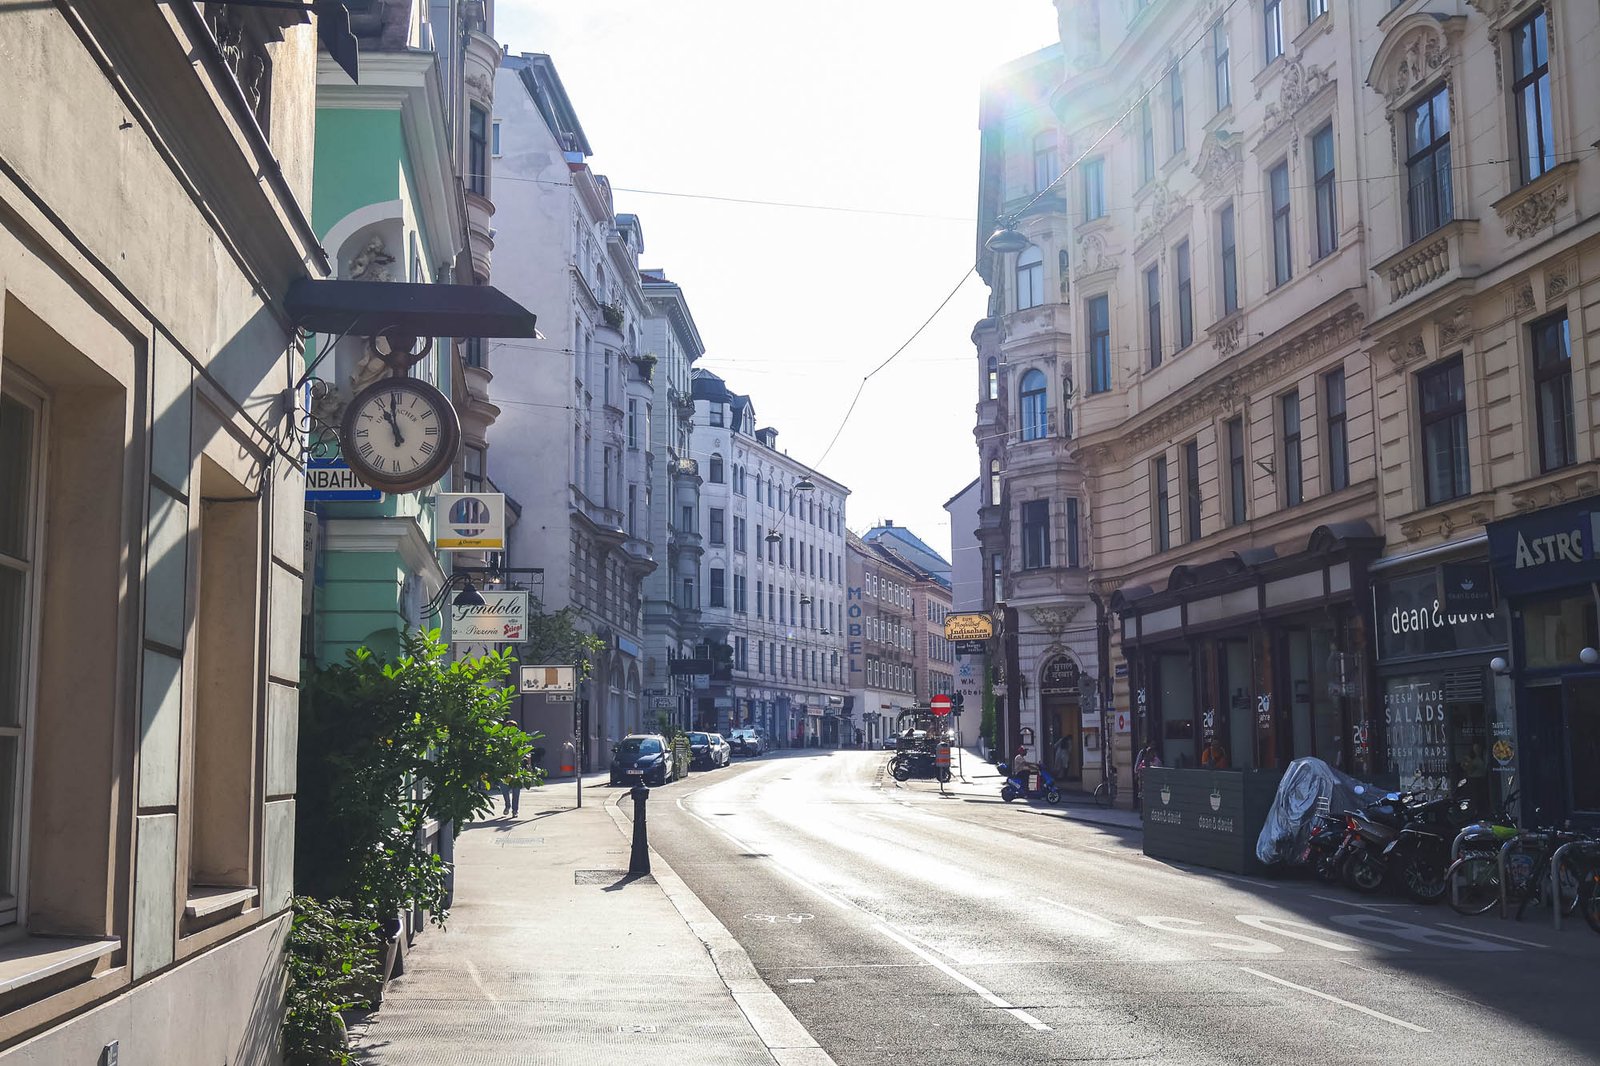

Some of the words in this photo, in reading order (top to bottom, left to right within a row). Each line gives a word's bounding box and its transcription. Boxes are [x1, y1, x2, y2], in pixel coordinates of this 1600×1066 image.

[465, 624, 498, 635] Pizzeria
[1384, 693, 1412, 704] FRESH
[1417, 690, 1443, 702] MADE
[1385, 703, 1445, 723] SALADS
[1387, 747, 1413, 758] FRESH
[1417, 746, 1447, 757] WRAPS
[1136, 914, 1525, 954] BUS
